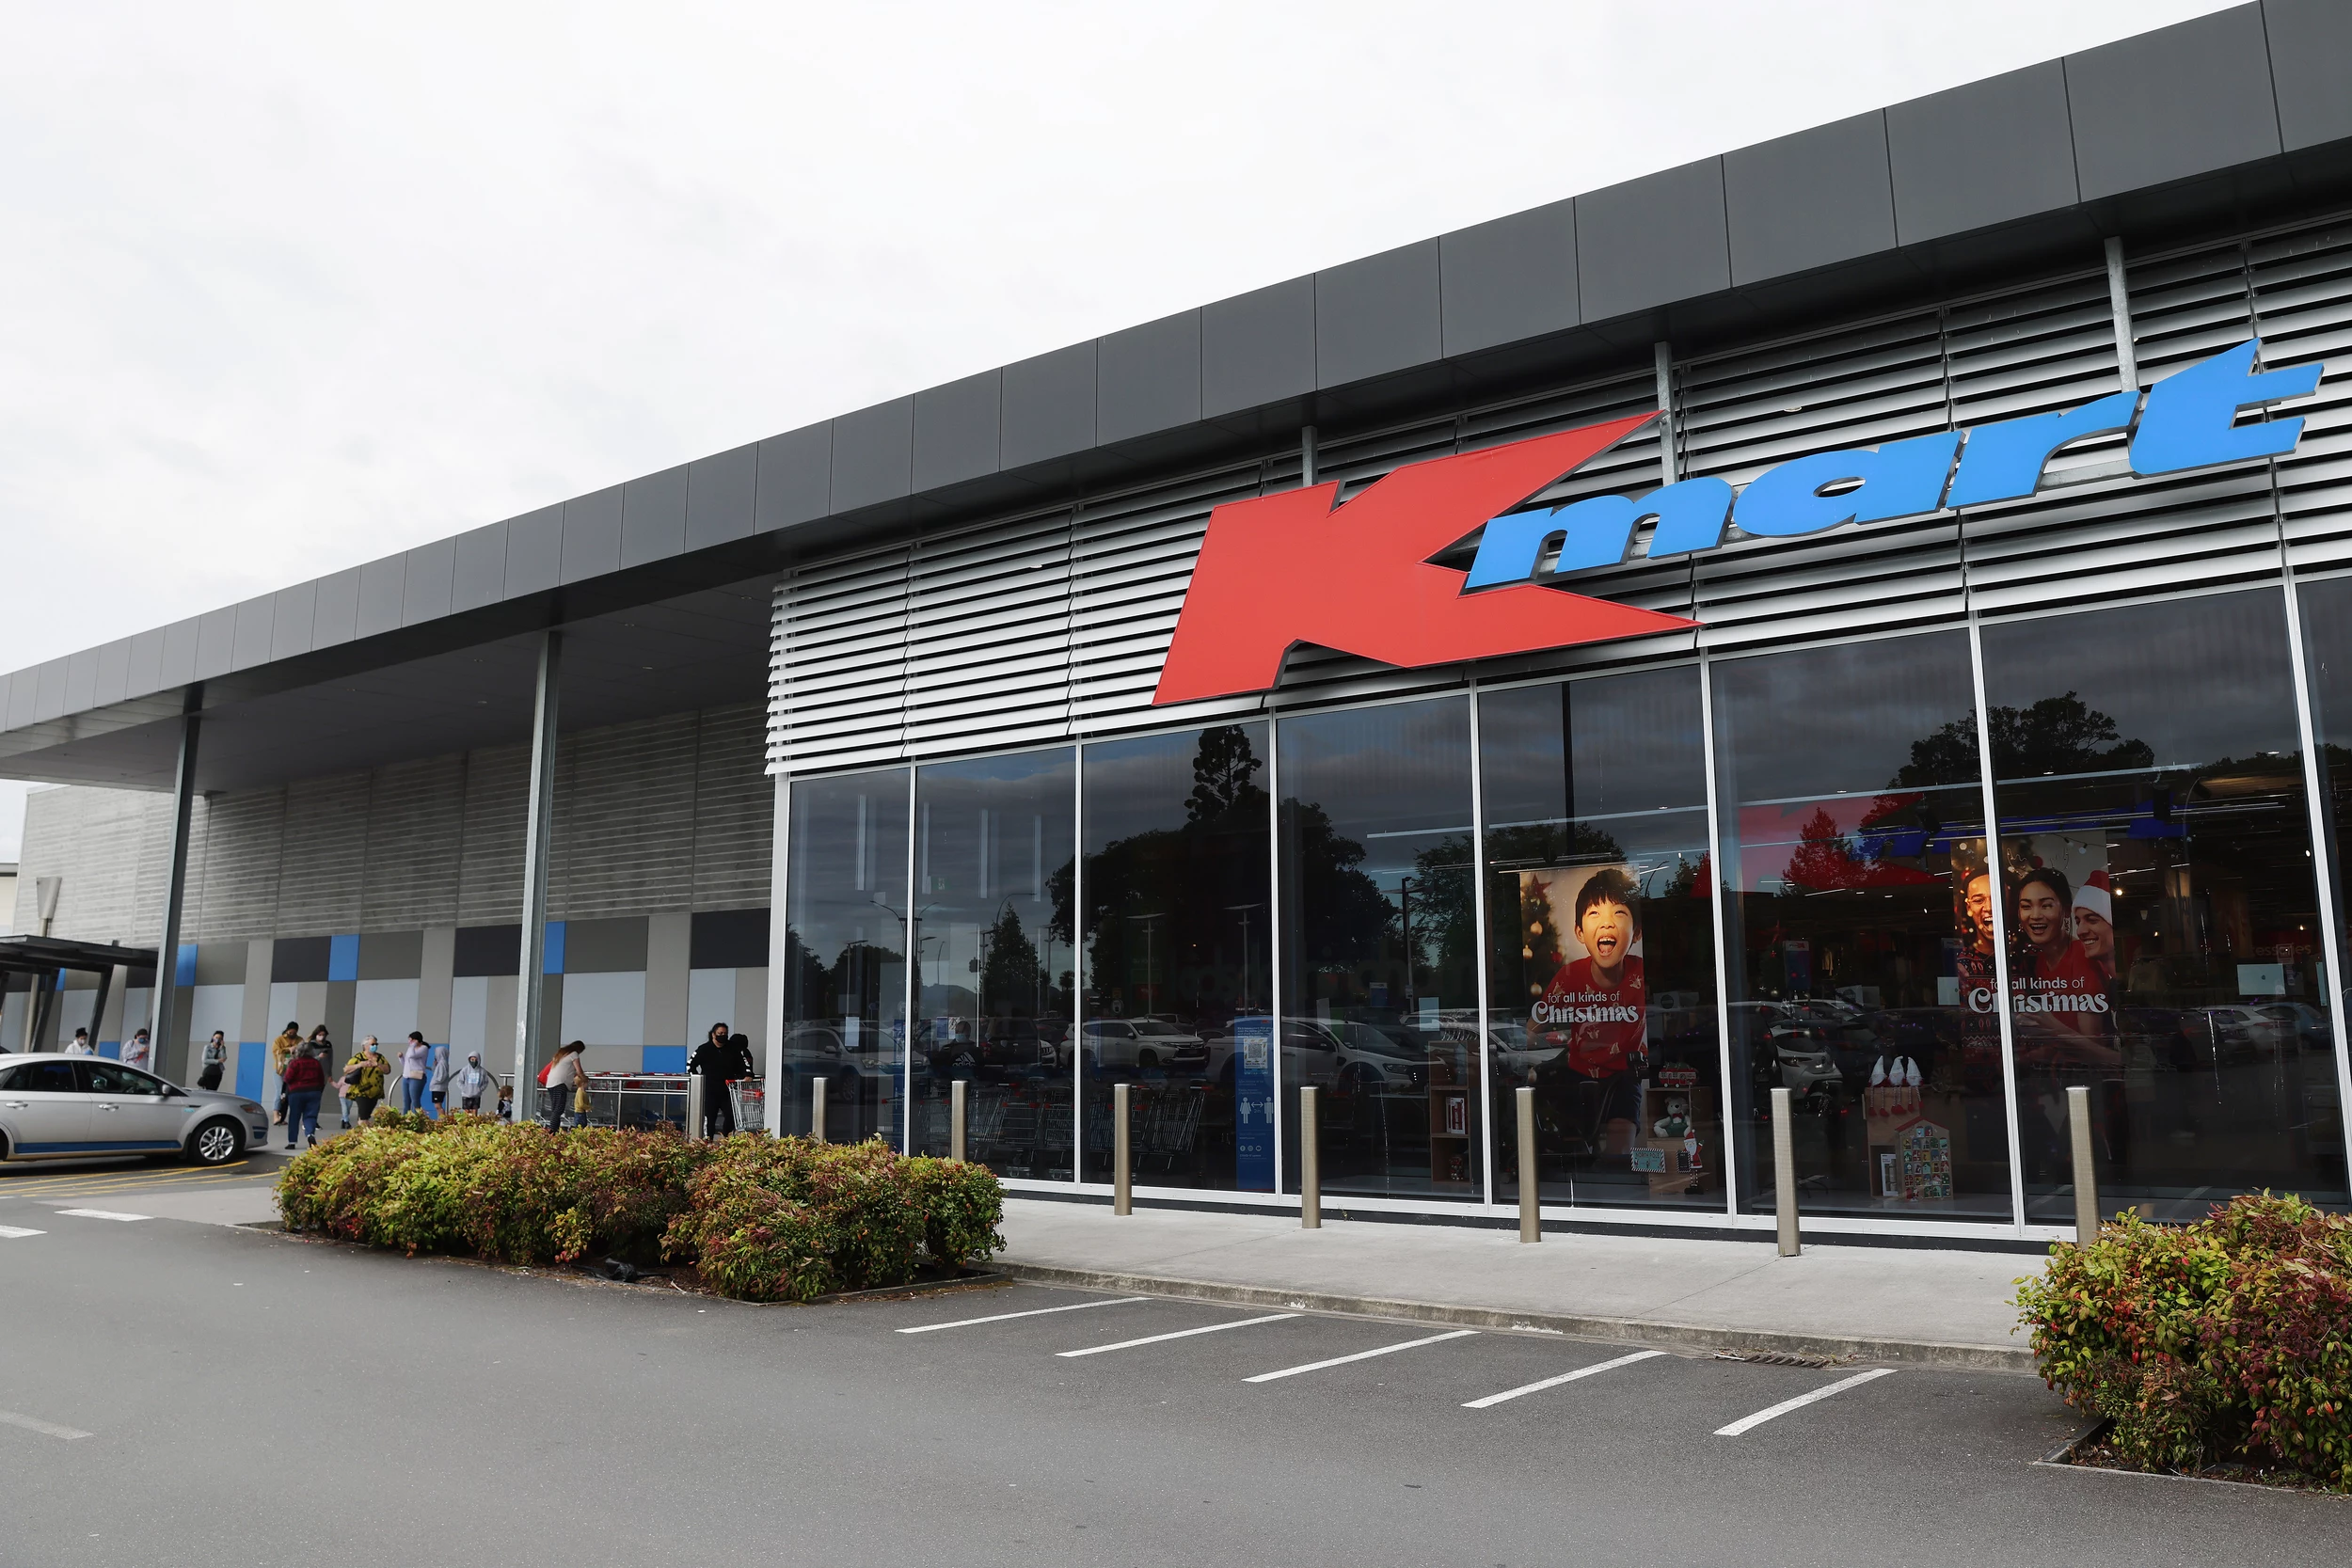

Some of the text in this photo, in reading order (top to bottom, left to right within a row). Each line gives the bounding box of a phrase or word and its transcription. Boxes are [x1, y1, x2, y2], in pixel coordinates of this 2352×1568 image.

[1151, 338, 2324, 706] Kmart
[2011, 977, 2026, 990] all
[2030, 976, 2068, 990] kinds
[2071, 975, 2085, 989] of
[1548, 990, 1621, 1004] for all kinds of
[1531, 1000, 1639, 1024] Christmas
